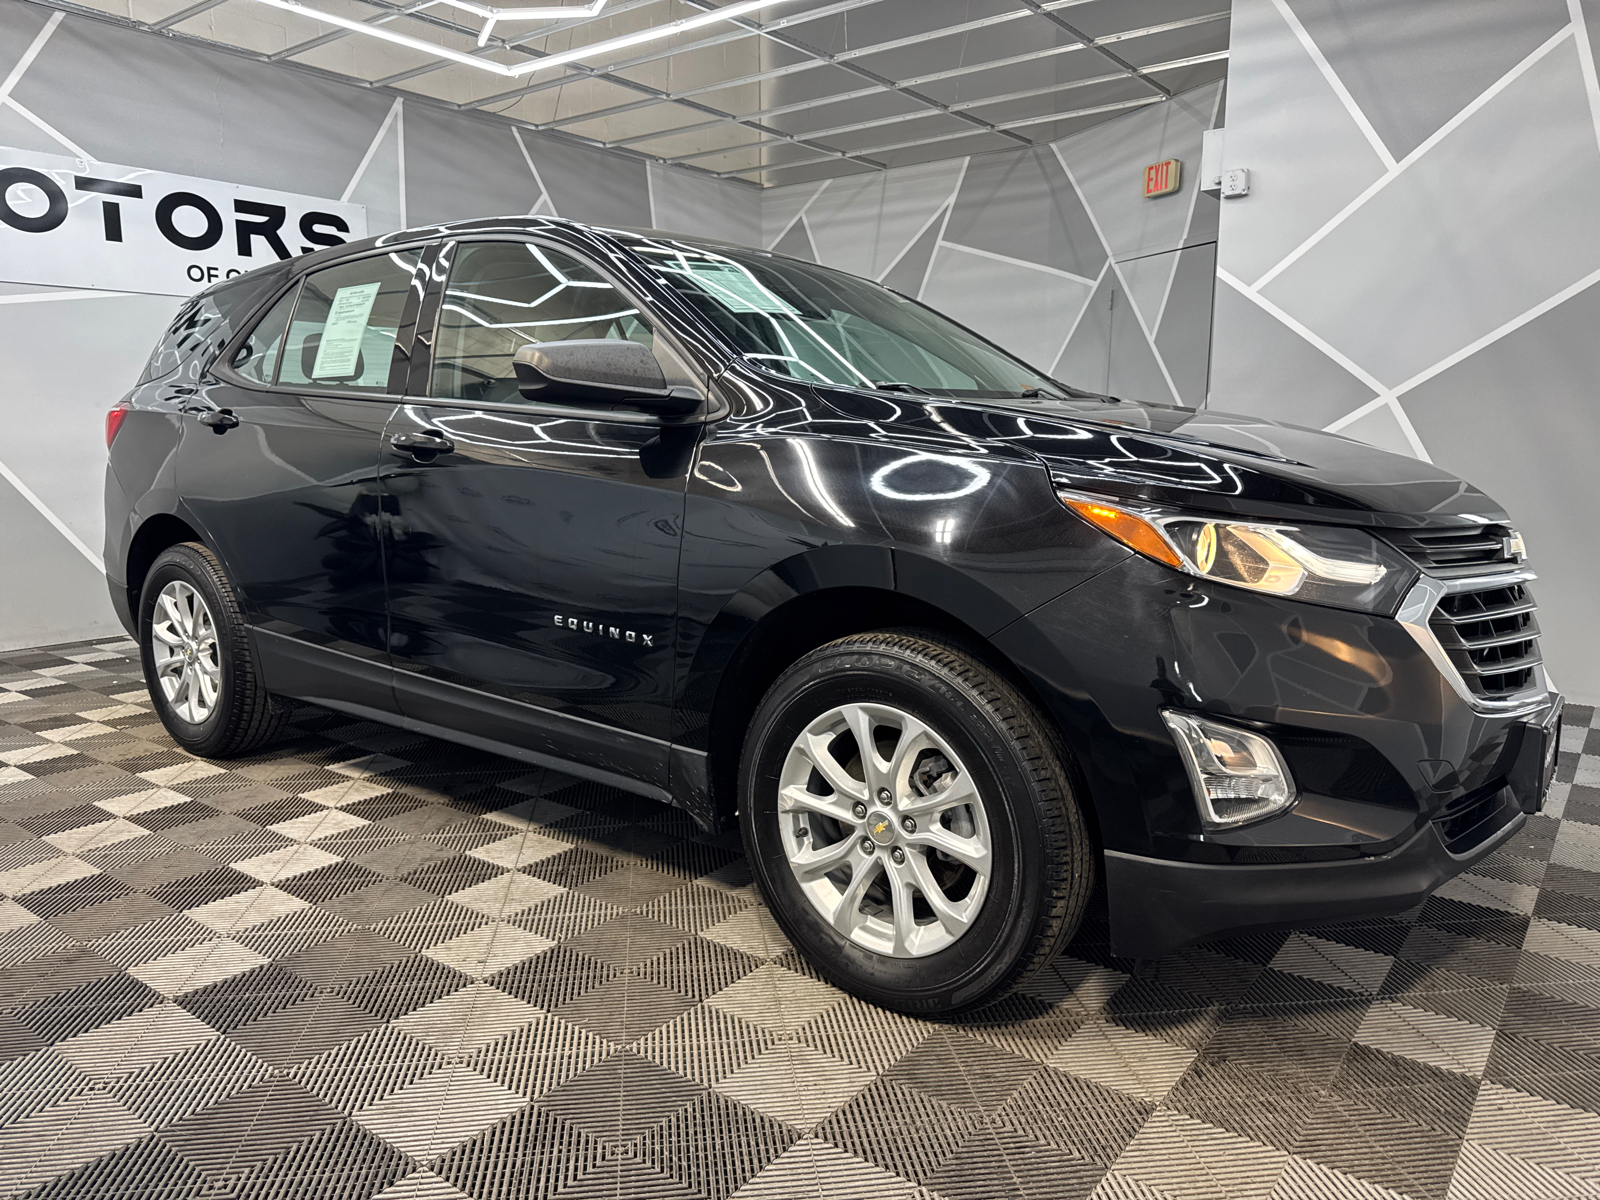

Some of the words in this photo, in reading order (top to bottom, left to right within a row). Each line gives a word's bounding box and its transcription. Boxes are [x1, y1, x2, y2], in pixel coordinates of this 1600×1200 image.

[1146, 161, 1171, 194] EXIT
[187, 264, 219, 283] OF
[554, 614, 653, 646] EQUINOX
